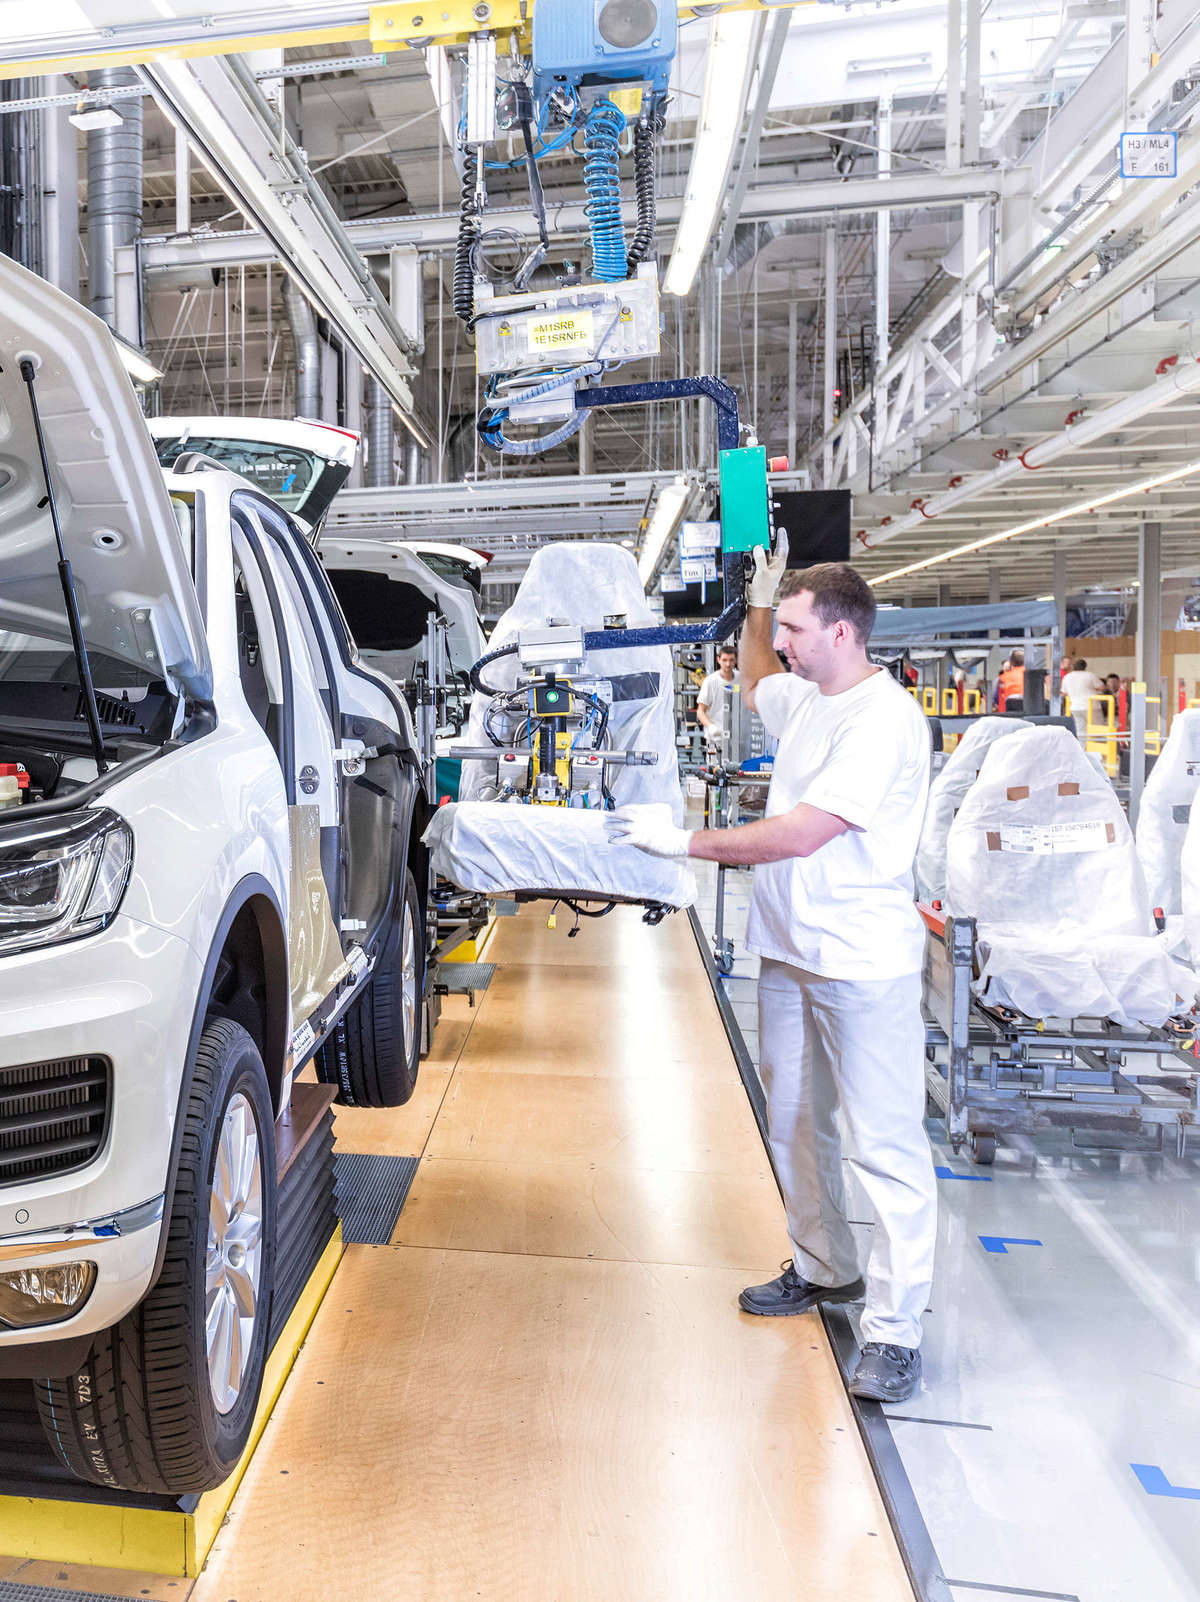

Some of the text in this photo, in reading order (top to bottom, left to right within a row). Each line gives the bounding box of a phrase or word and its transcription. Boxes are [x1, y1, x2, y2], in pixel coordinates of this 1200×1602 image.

[1128, 140, 1141, 149] H3
[1149, 139, 1169, 149] ML4
[1131, 162, 1169, 172] F 161
[78, 1375, 92, 1403] 7D3
